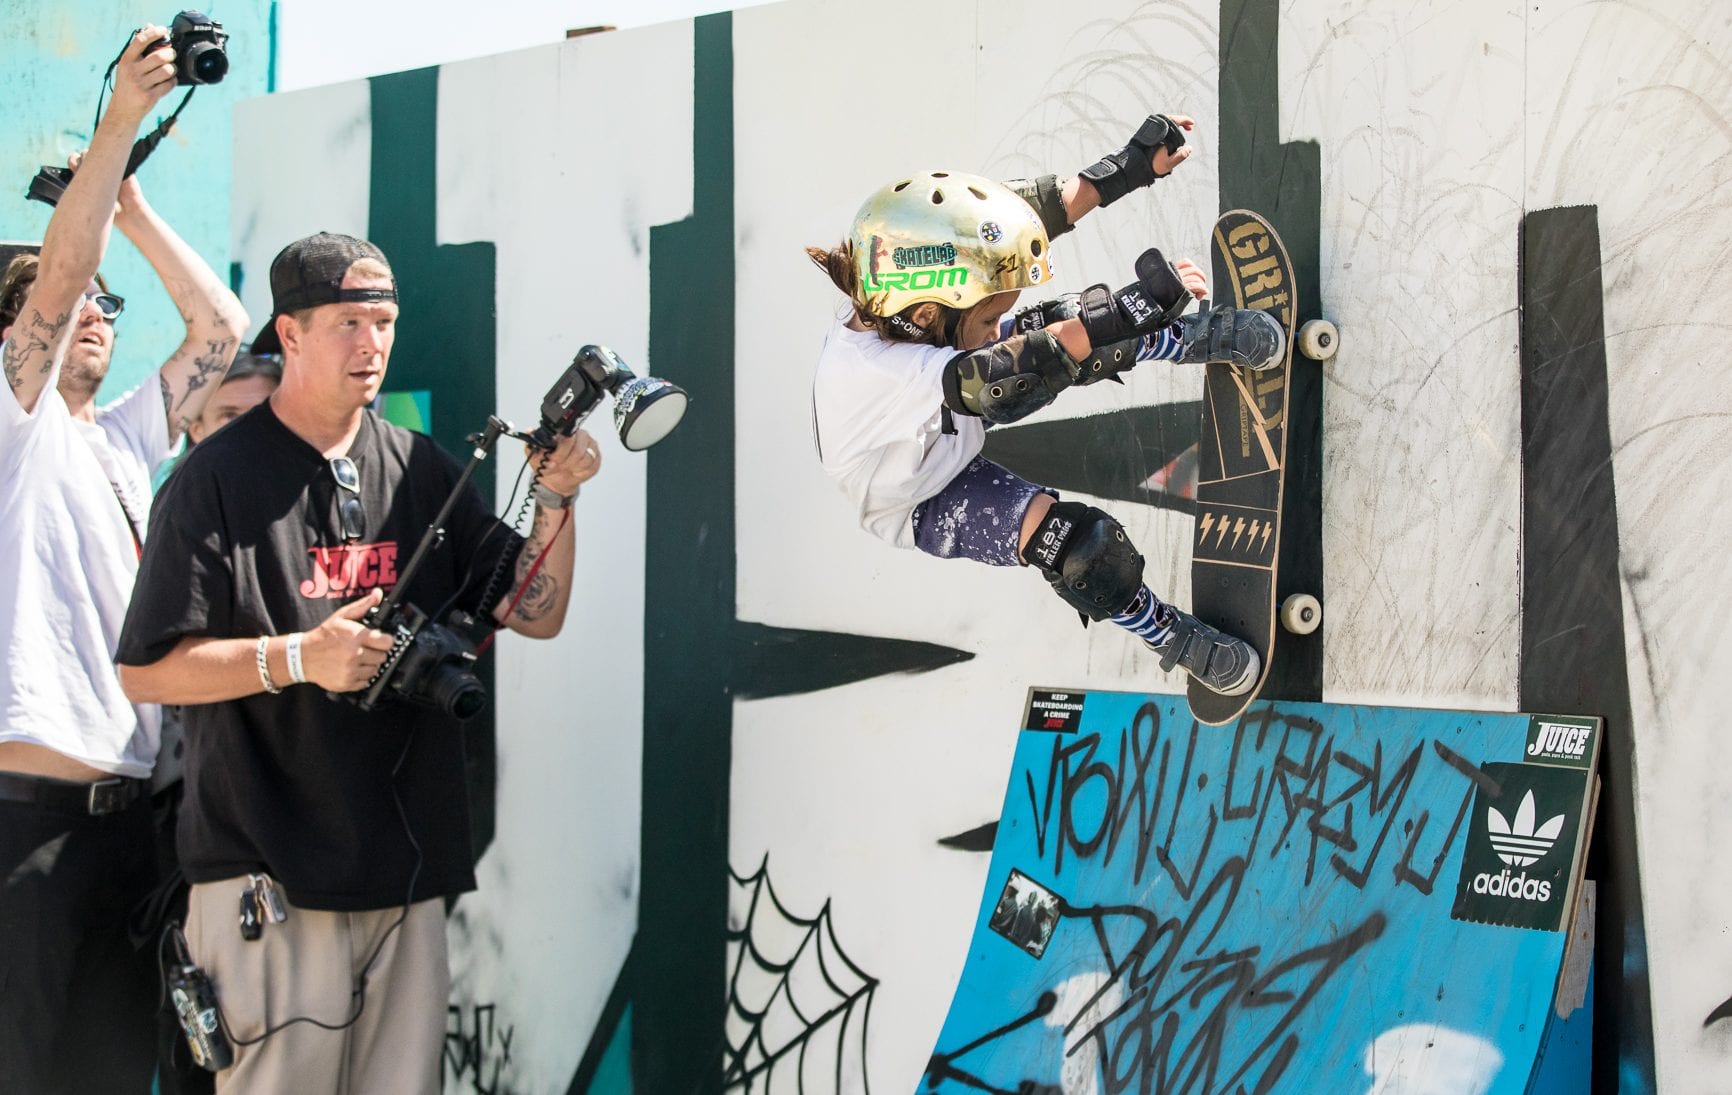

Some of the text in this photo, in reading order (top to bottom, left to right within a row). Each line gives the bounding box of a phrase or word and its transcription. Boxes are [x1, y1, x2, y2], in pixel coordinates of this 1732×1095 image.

[892, 246, 957, 267] SKATELAB
[1129, 291, 1153, 317] 187
[1037, 518, 1062, 559] 187
[1045, 521, 1073, 566] KILLER PADS
[300, 542, 397, 598] JUICE
[1032, 701, 1084, 711] SKATEBOARDING
[1049, 711, 1071, 719] CRIME
[1528, 722, 1592, 755] JUICE
[1473, 869, 1551, 902] adidas
